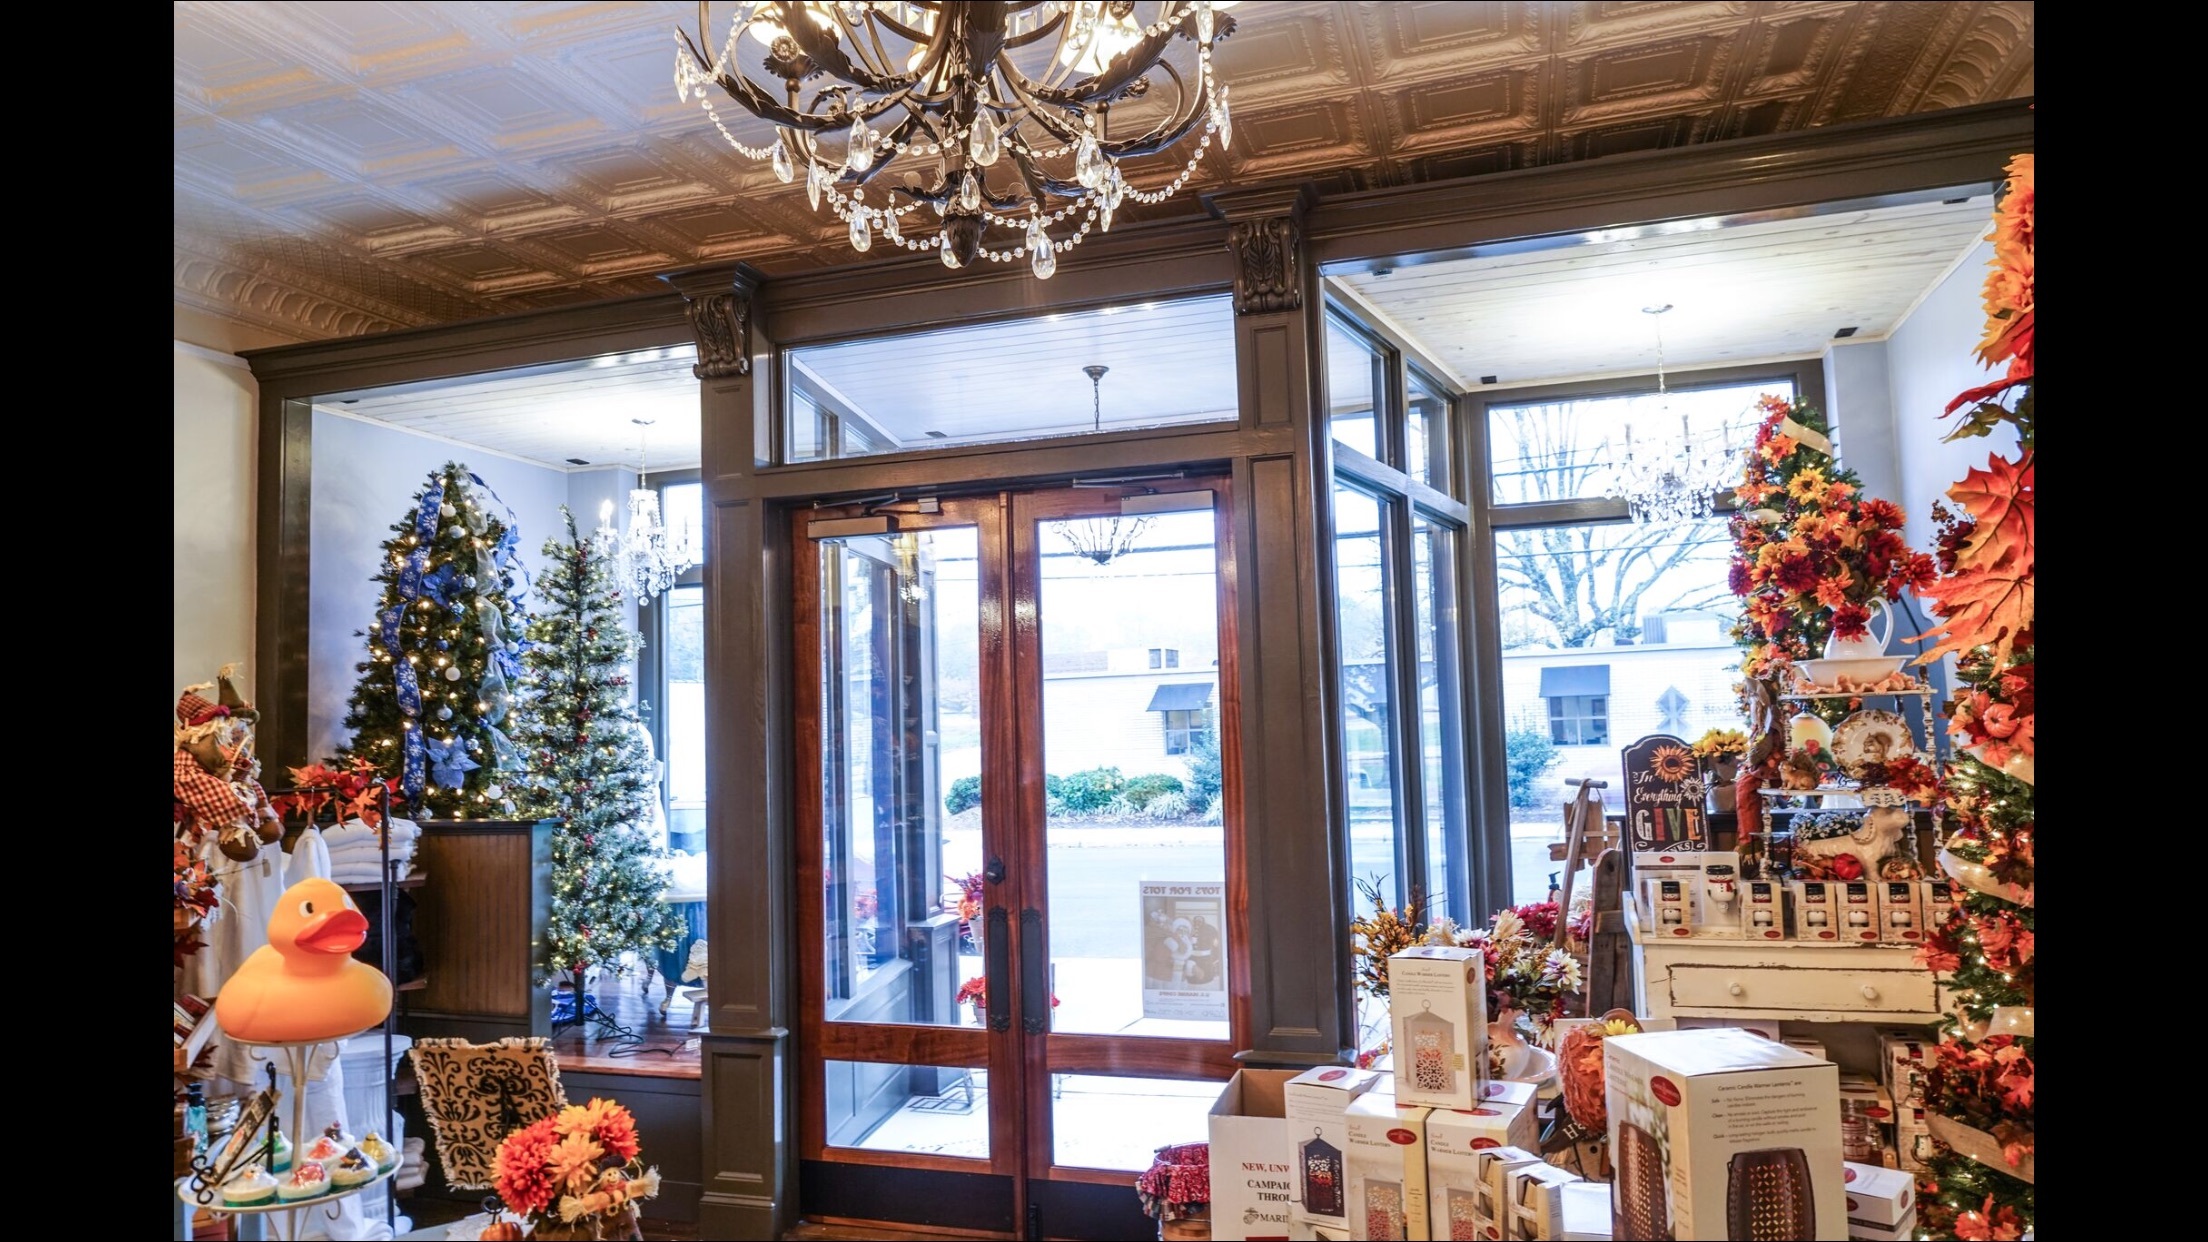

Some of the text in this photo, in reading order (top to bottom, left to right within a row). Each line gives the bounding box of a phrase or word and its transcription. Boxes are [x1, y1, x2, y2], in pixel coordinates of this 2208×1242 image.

[1632, 770, 1653, 785] In
[1633, 786, 1683, 807] Everything
[1635, 808, 1702, 841] GIVE
[1242, 1162, 1267, 1172] NEW,
[1260, 1213, 1289, 1223] MARI
